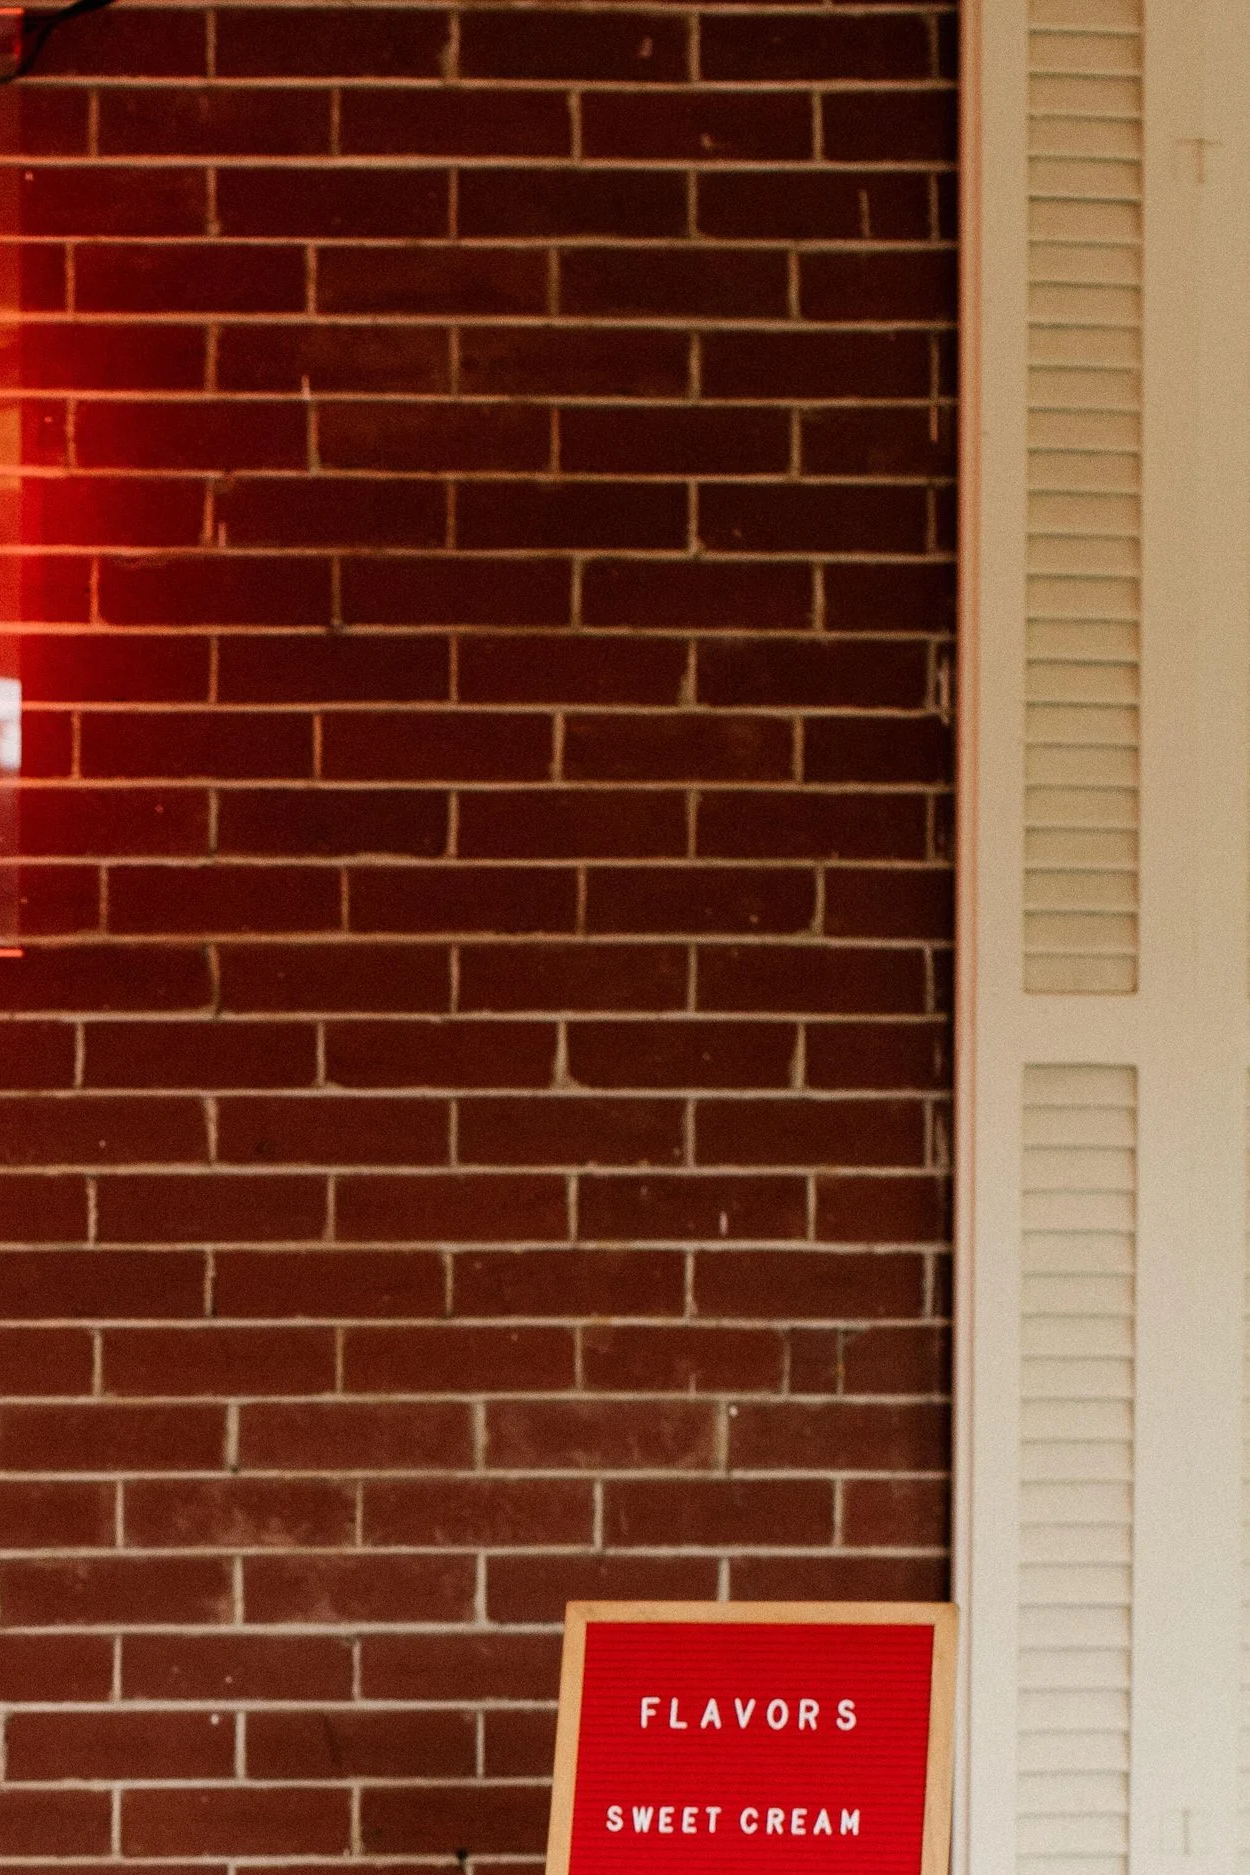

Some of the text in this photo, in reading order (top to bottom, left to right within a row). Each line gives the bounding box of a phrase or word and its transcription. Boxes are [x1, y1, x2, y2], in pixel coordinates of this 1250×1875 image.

[640, 1696, 857, 1731] FLAVORS
[605, 1805, 861, 1836] SWEET CREAM
